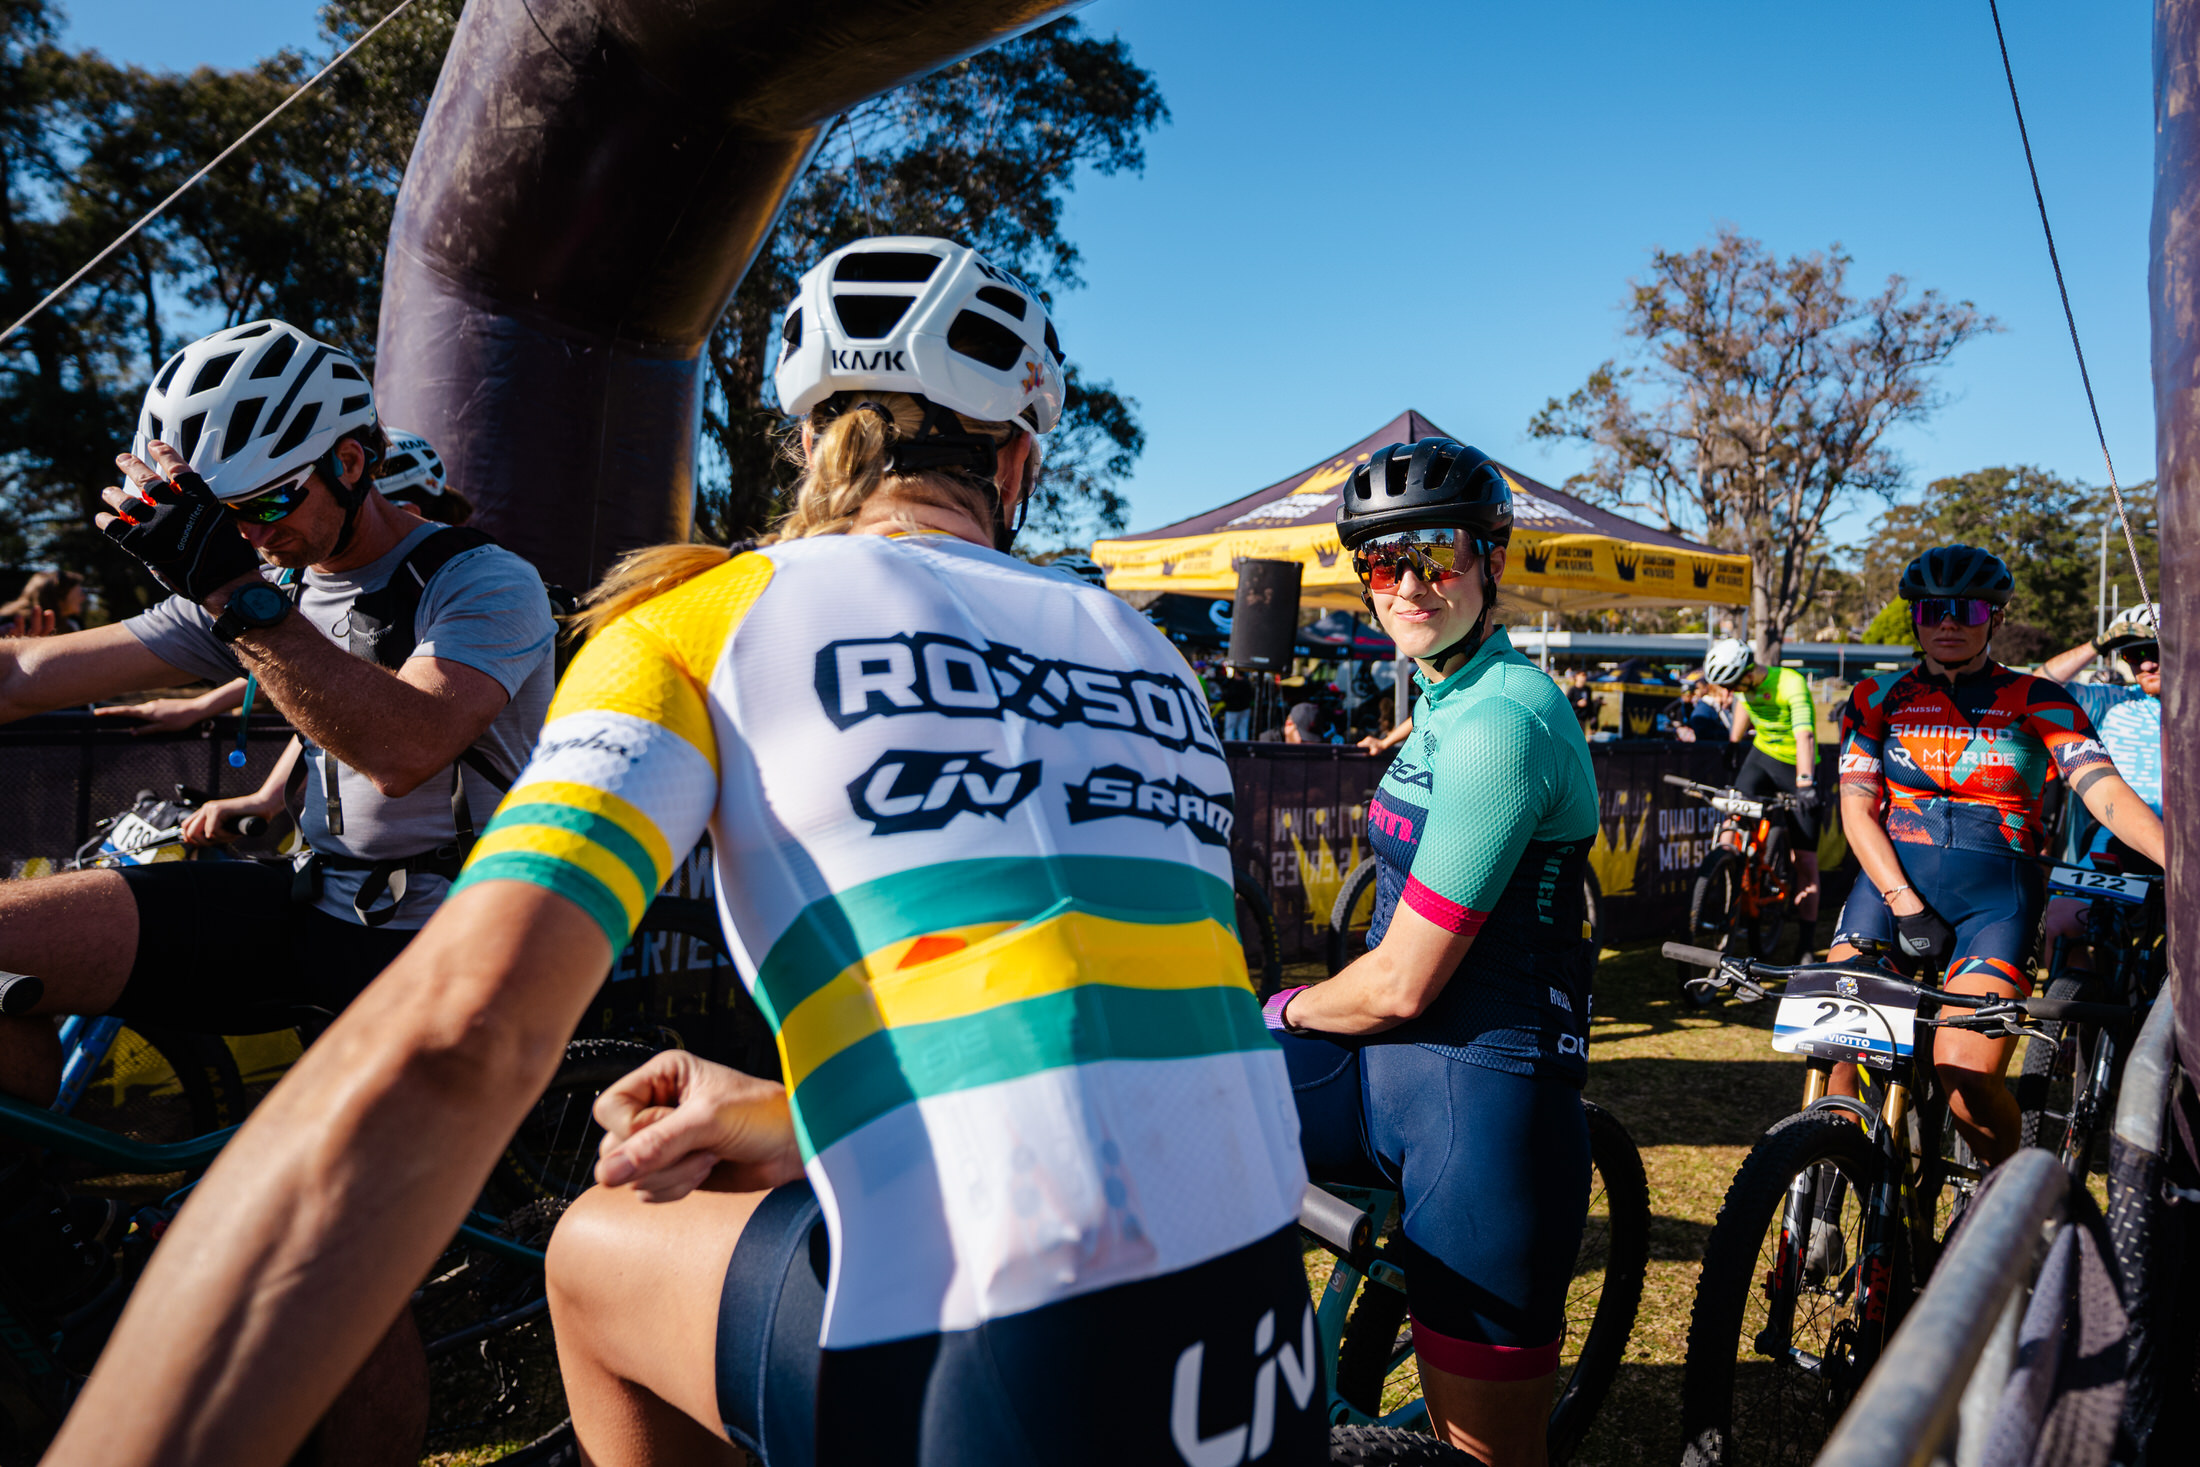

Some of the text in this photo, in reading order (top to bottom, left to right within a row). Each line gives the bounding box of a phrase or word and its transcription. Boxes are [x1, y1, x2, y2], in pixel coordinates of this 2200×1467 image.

[831, 350, 906, 371] KASK
[1904, 705, 1942, 713] Aussie
[1890, 724, 2014, 742] SHIMANO
[1923, 748, 2016, 767] MY RIDE
[864, 758, 1022, 817] Liv
[1088, 776, 1234, 842] SRAM
[1659, 808, 1695, 840] QUAD
[1659, 840, 1690, 872] MTB
[2070, 871, 2128, 893] 122
[1813, 1001, 1868, 1034] 22
[1828, 1034, 1871, 1048] VIOTTO
